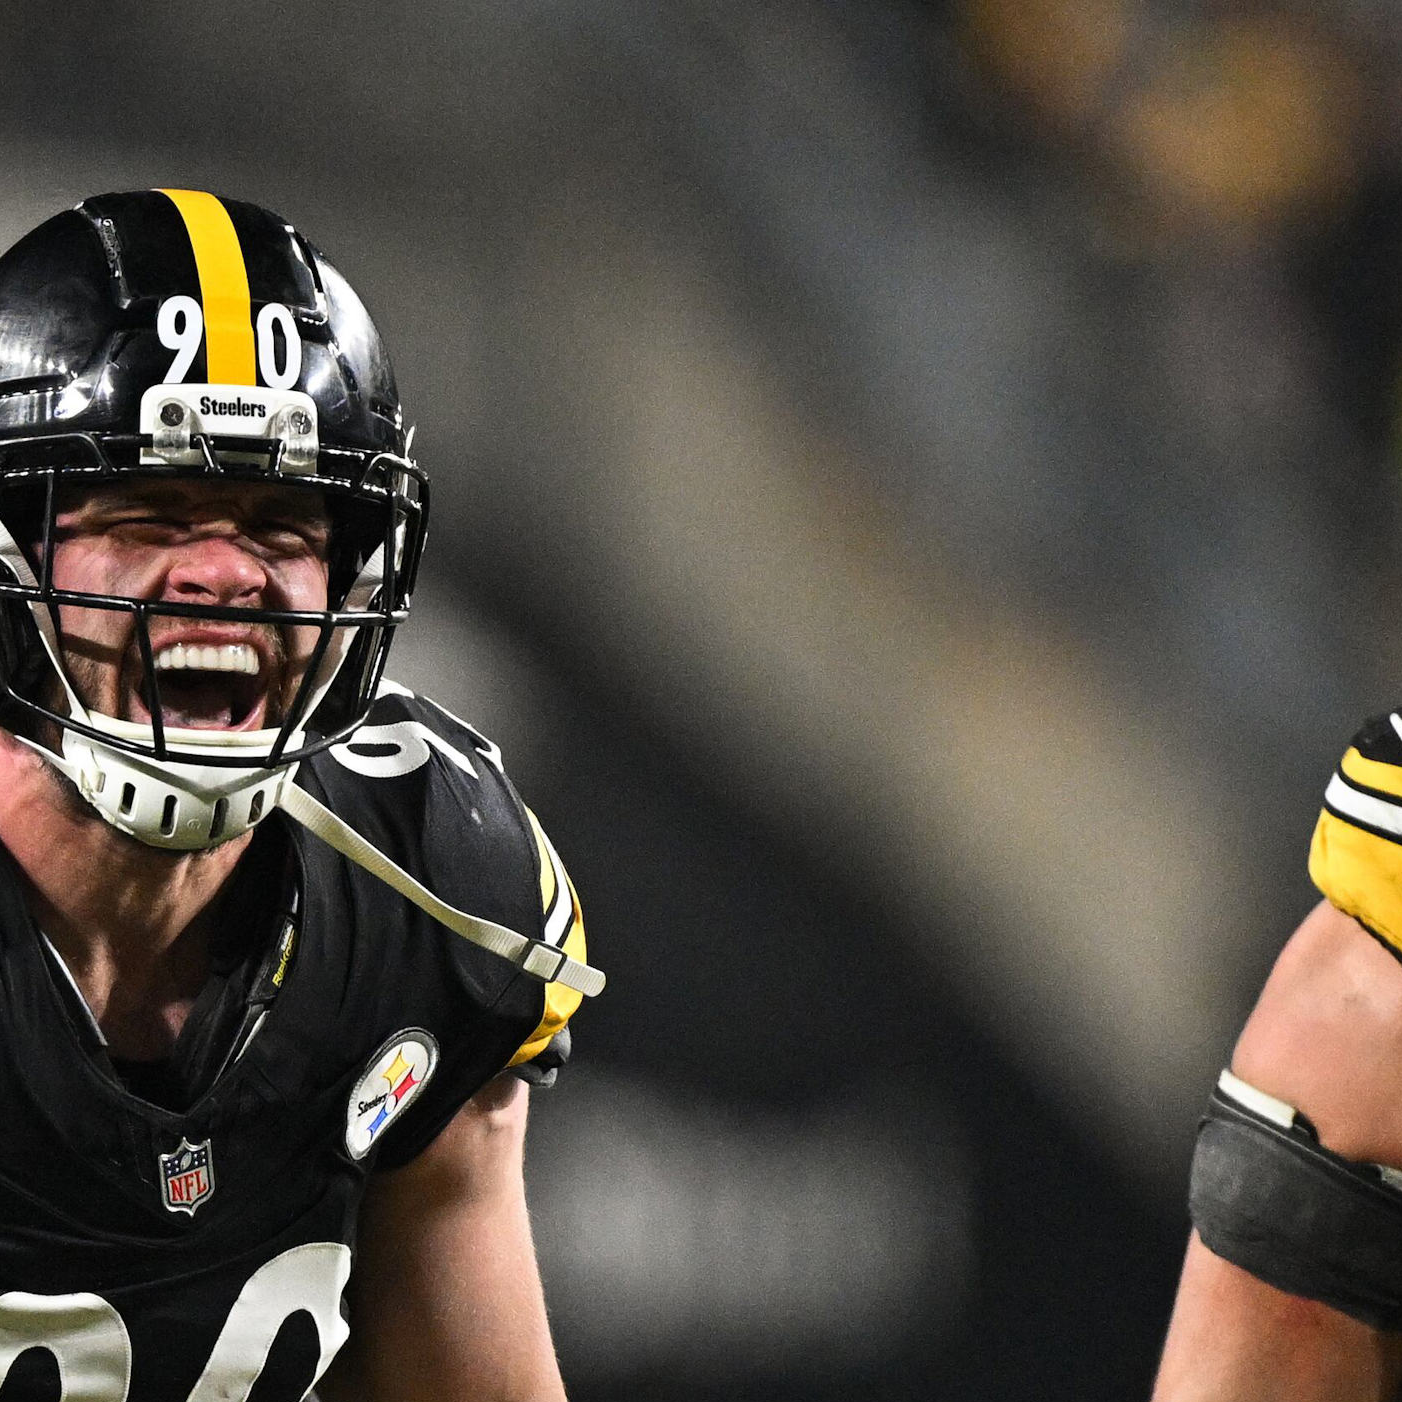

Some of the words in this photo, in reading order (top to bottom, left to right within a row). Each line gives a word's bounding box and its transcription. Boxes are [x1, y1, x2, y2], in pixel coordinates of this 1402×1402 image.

[156, 295, 302, 391] 90
[200, 396, 266, 418] Steelers
[169, 1170, 207, 1202] NFL
